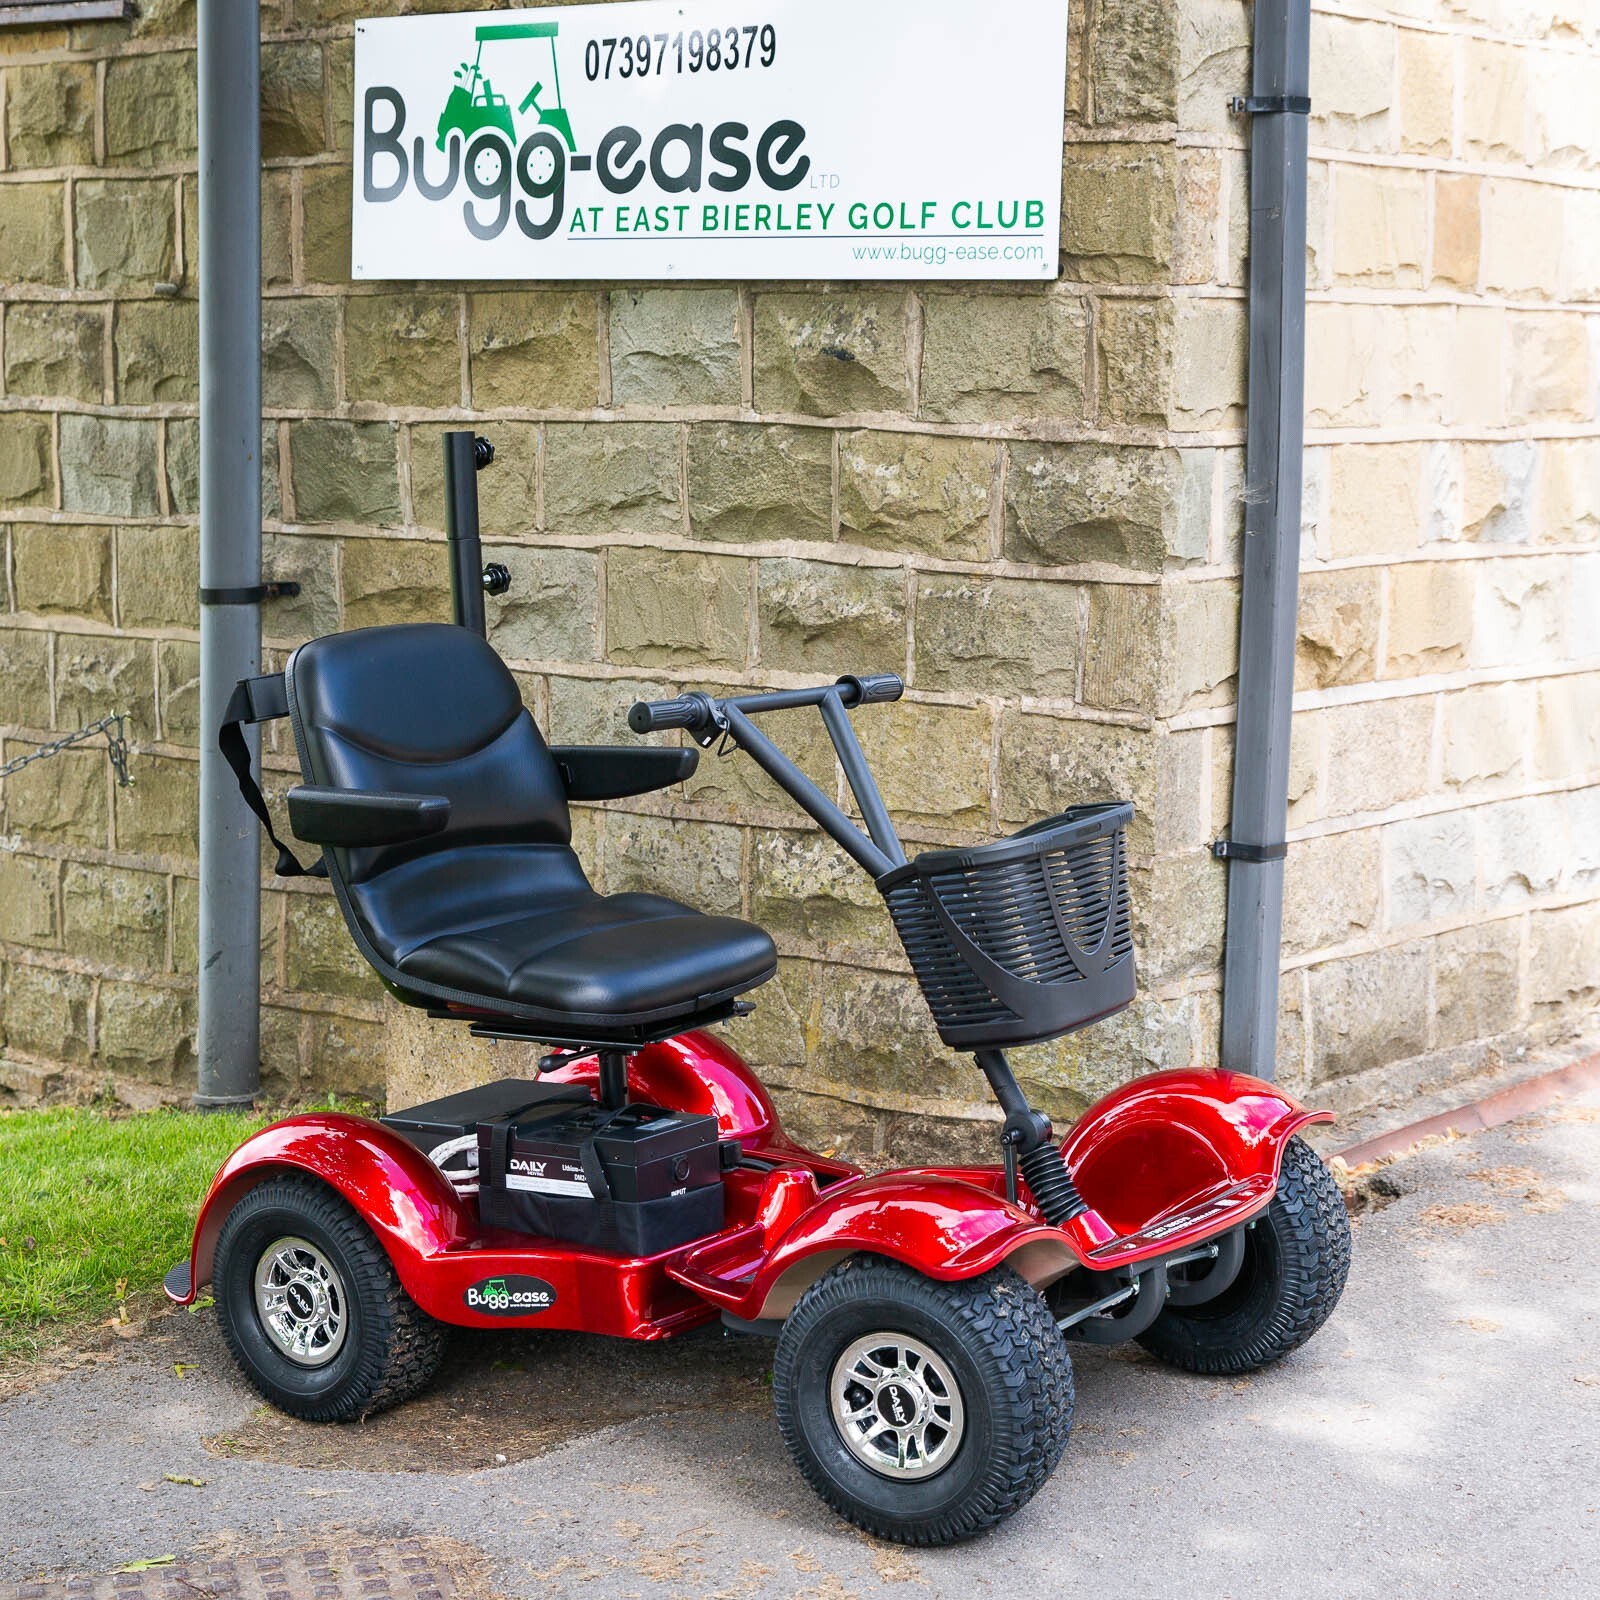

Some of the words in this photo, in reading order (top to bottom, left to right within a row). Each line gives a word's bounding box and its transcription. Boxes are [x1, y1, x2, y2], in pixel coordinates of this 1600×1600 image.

[585, 23, 776, 82] 07397198379
[364, 86, 811, 241] Bugg-ease
[810, 174, 840, 189] LTD
[569, 207, 604, 232] AT
[616, 206, 690, 232] EAST
[702, 203, 835, 231] BIERLEY
[848, 202, 937, 230] GOLF
[951, 200, 1044, 229] CLUB
[852, 242, 1043, 265] www.bugg-ease.com
[510, 1159, 547, 1173] DAILY
[290, 1286, 312, 1313] DAILY
[467, 1287, 549, 1309] Bugg-ease
[889, 1386, 908, 1424] DAILY
